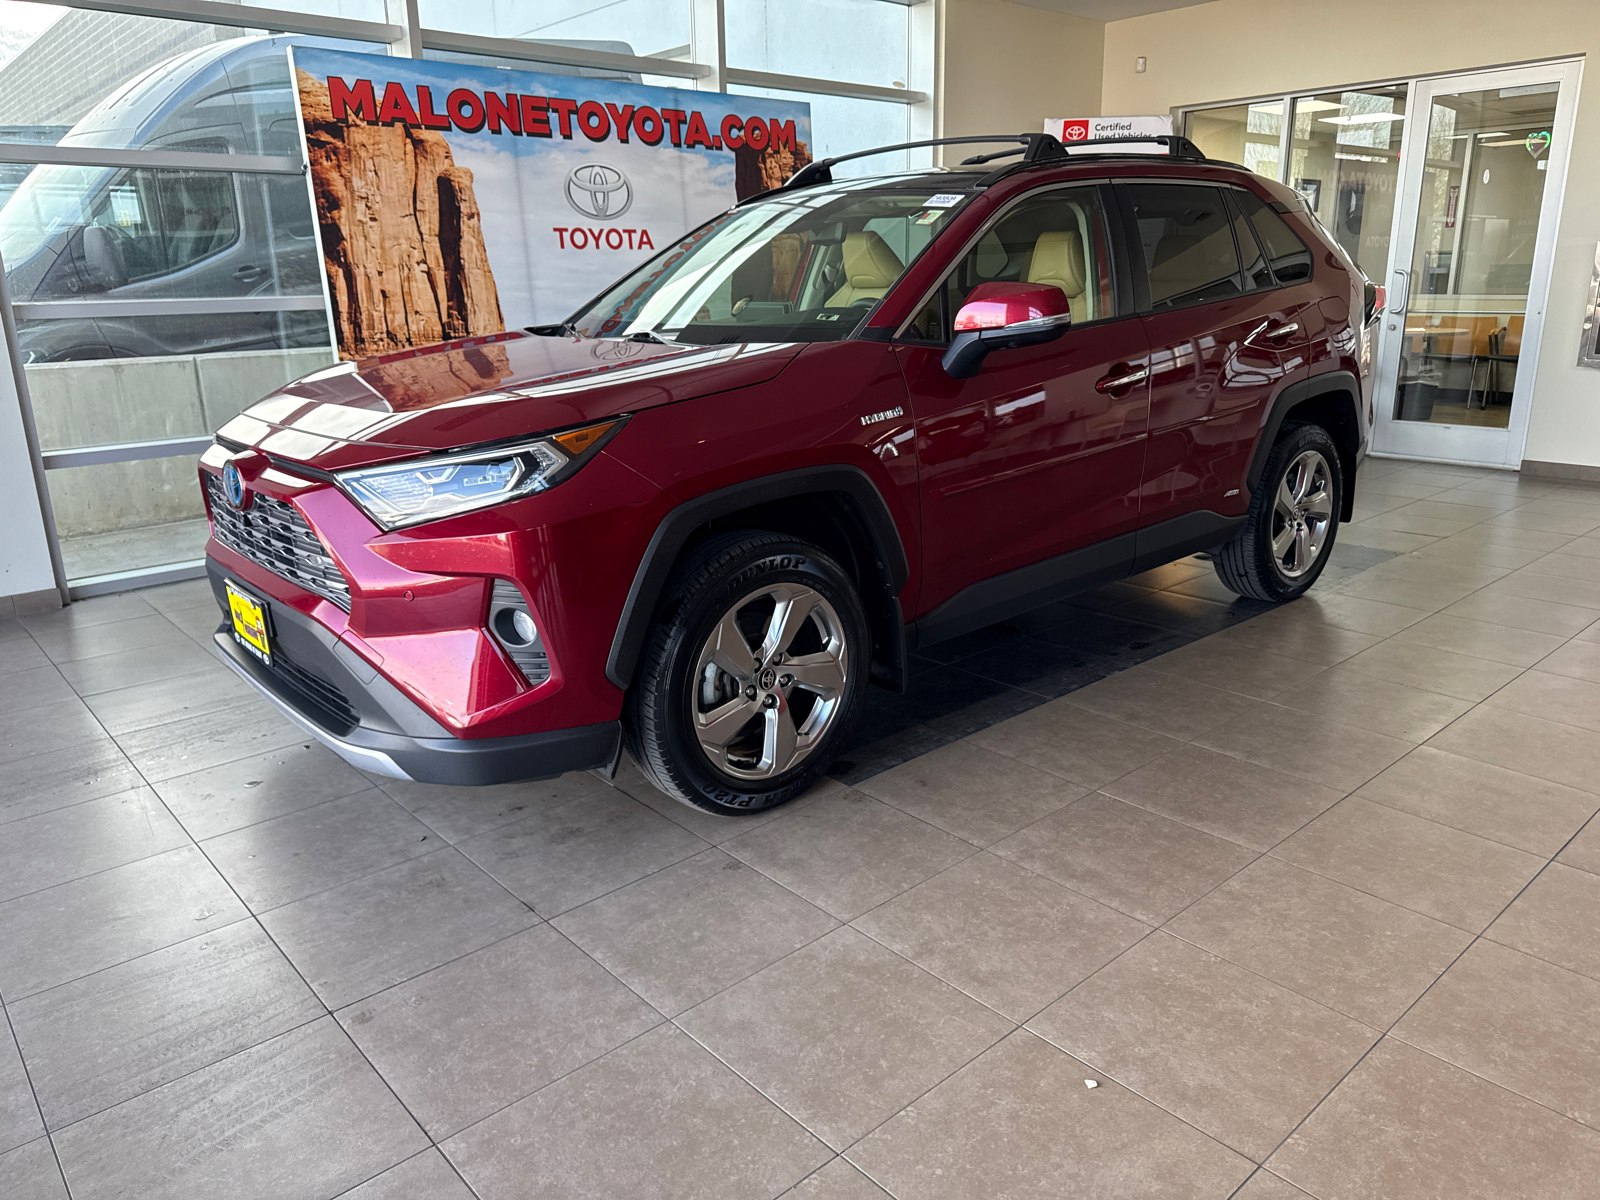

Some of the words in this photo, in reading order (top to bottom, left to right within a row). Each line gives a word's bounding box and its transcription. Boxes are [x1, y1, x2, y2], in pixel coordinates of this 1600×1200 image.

[326, 75, 797, 152] MALONETOYOTA.COM
[1094, 122, 1132, 132] Certified
[553, 227, 655, 250] TOYOTA
[861, 407, 901, 426] HYBRID
[726, 556, 808, 591] DUNLOP
[701, 783, 757, 808] PT20
